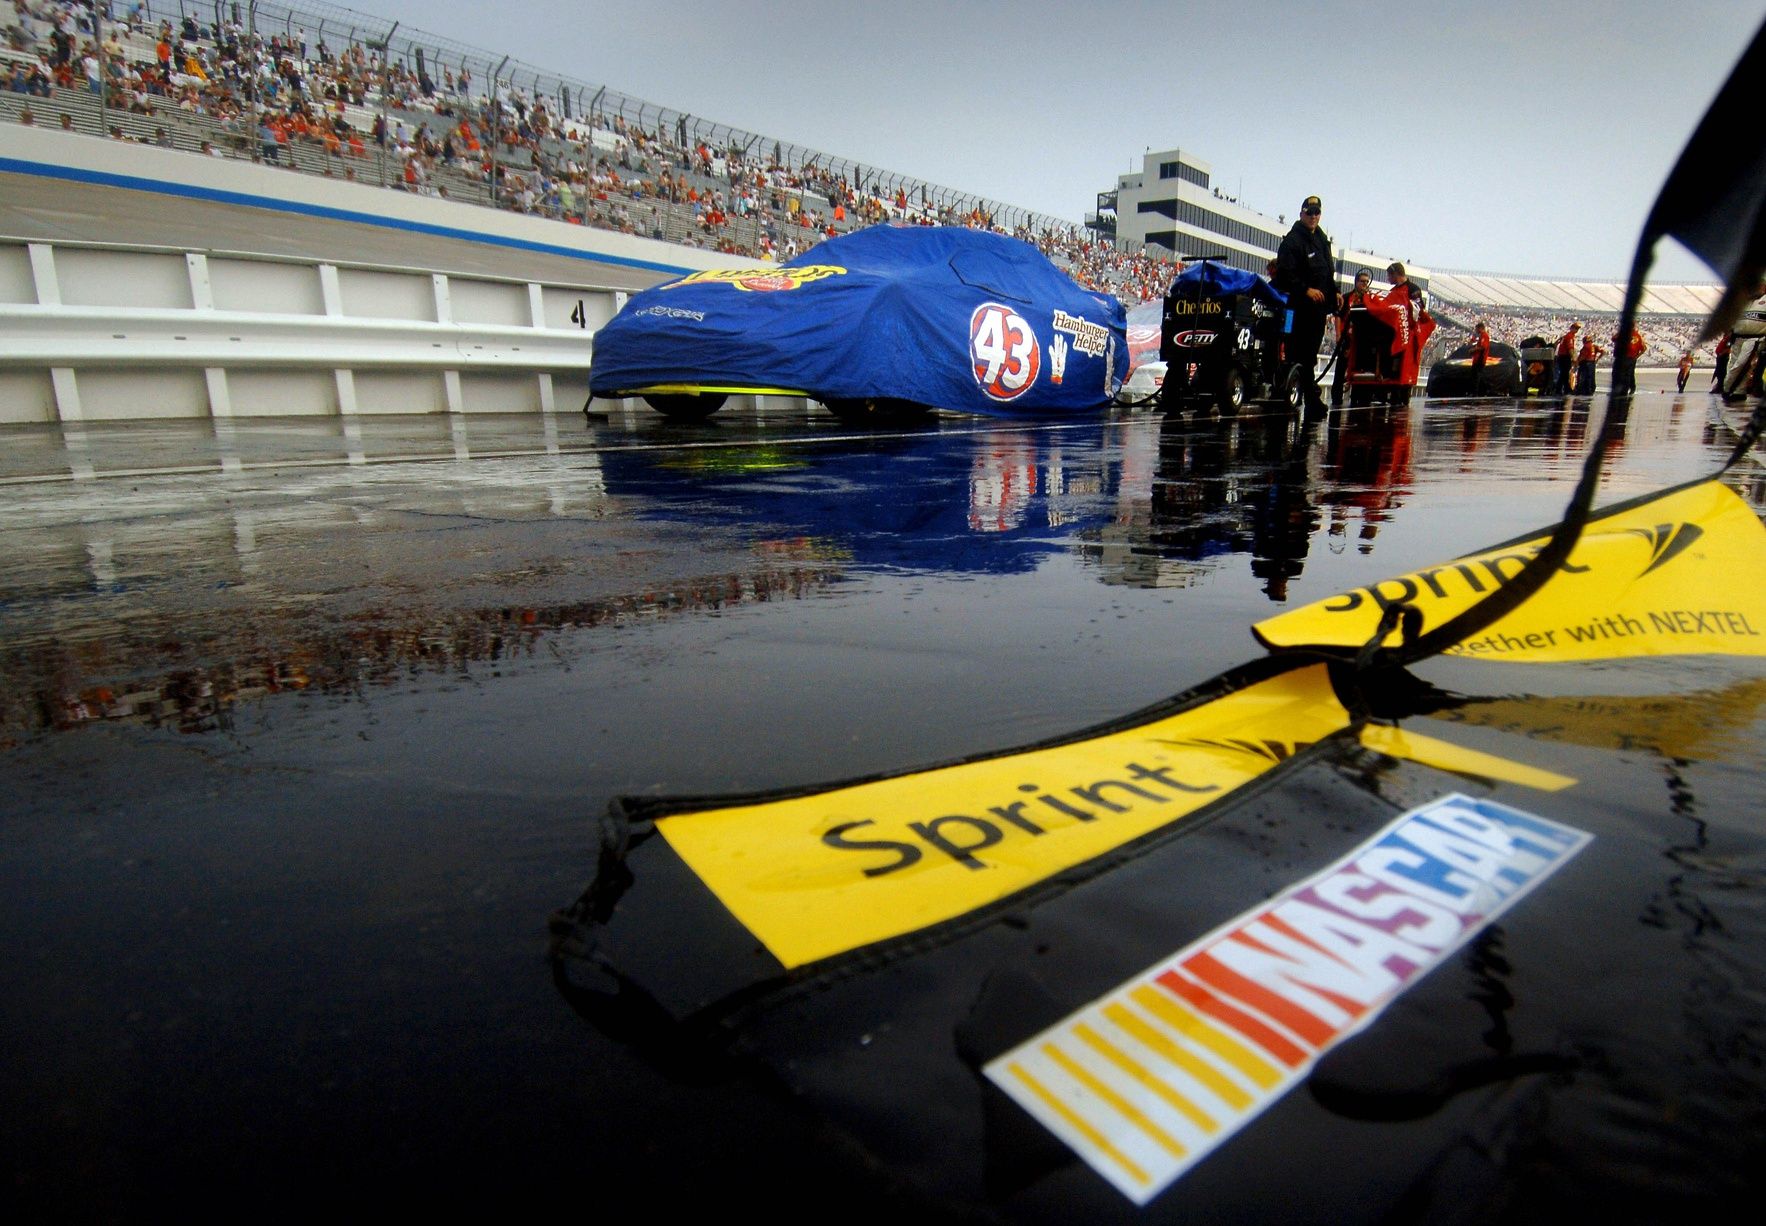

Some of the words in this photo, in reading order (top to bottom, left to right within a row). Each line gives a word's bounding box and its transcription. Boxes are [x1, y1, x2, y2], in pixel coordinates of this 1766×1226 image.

[570, 299, 586, 329] 4
[1176, 298, 1221, 315] Cherios
[1055, 312, 1109, 339] Hamburger
[1237, 328, 1251, 350] 43
[974, 308, 1034, 390] 43
[1074, 334, 1106, 354] Helper
[1325, 543, 1592, 612] prin
[1564, 612, 1647, 643] with
[1647, 611, 1760, 635] NEXTEL
[821, 762, 1221, 878] Sprint
[1207, 801, 1573, 1032] NASCAR
